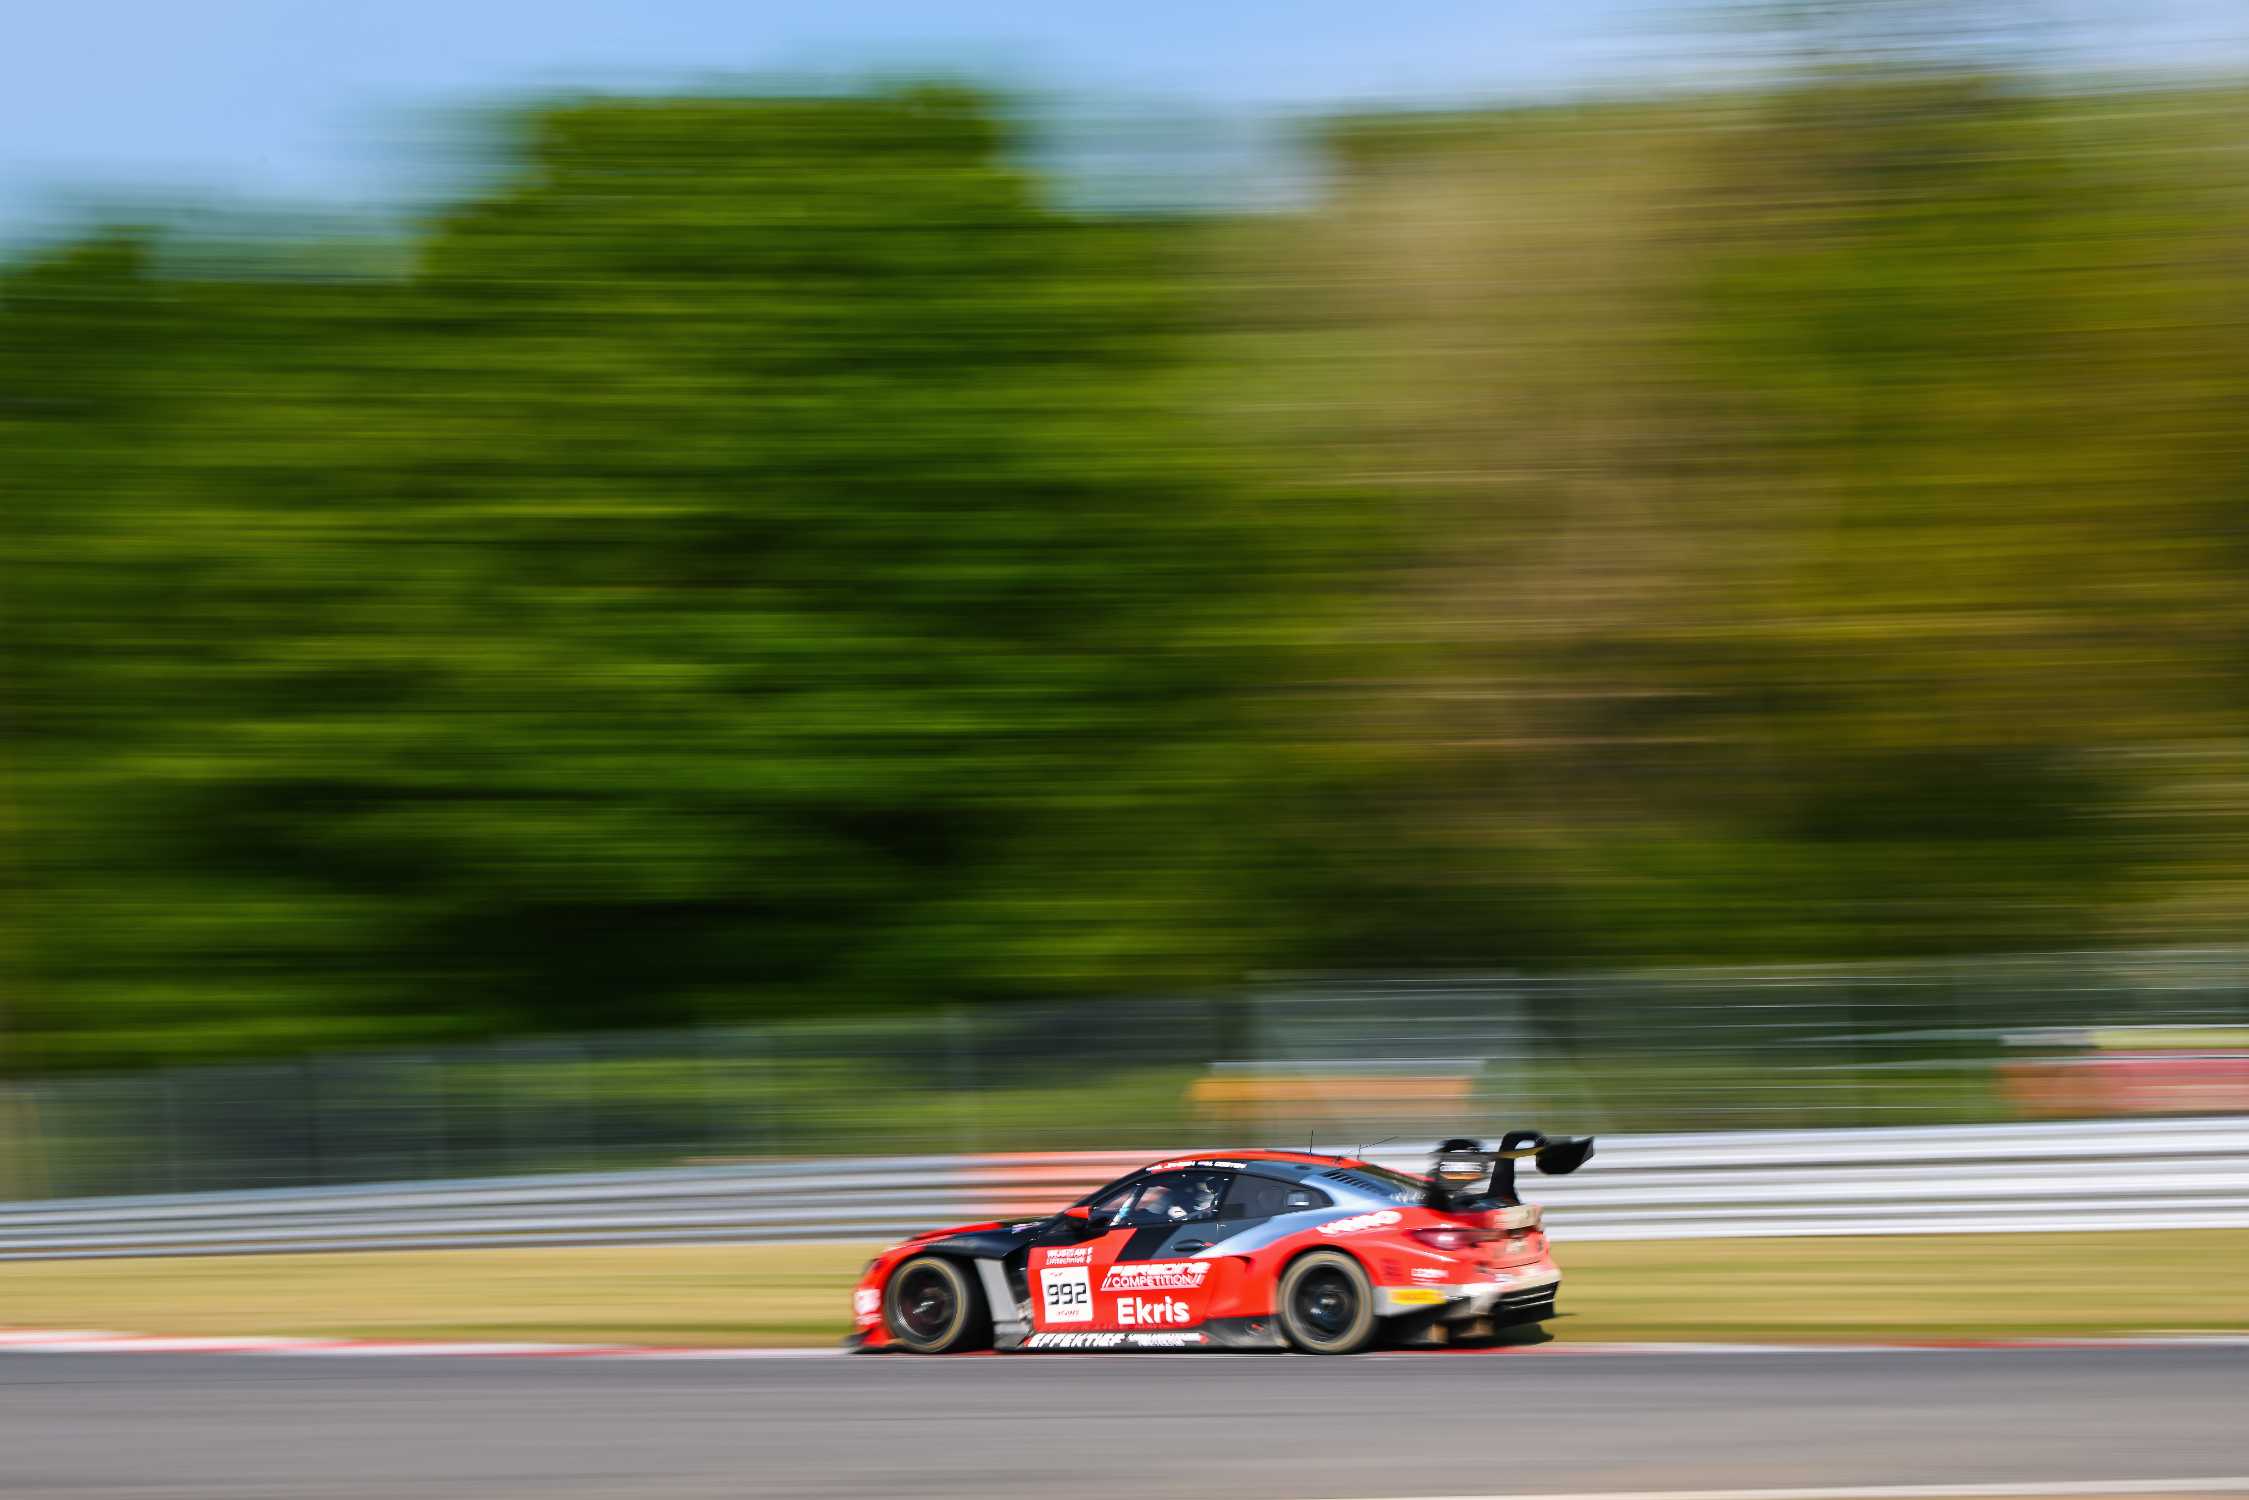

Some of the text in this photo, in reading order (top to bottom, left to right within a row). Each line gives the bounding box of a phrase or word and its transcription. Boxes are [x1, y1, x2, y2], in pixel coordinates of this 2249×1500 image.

[1112, 1273, 1193, 1288] COMPETITION
[1047, 1282, 1088, 1305] 992
[1117, 1296, 1191, 1325] Ekris
